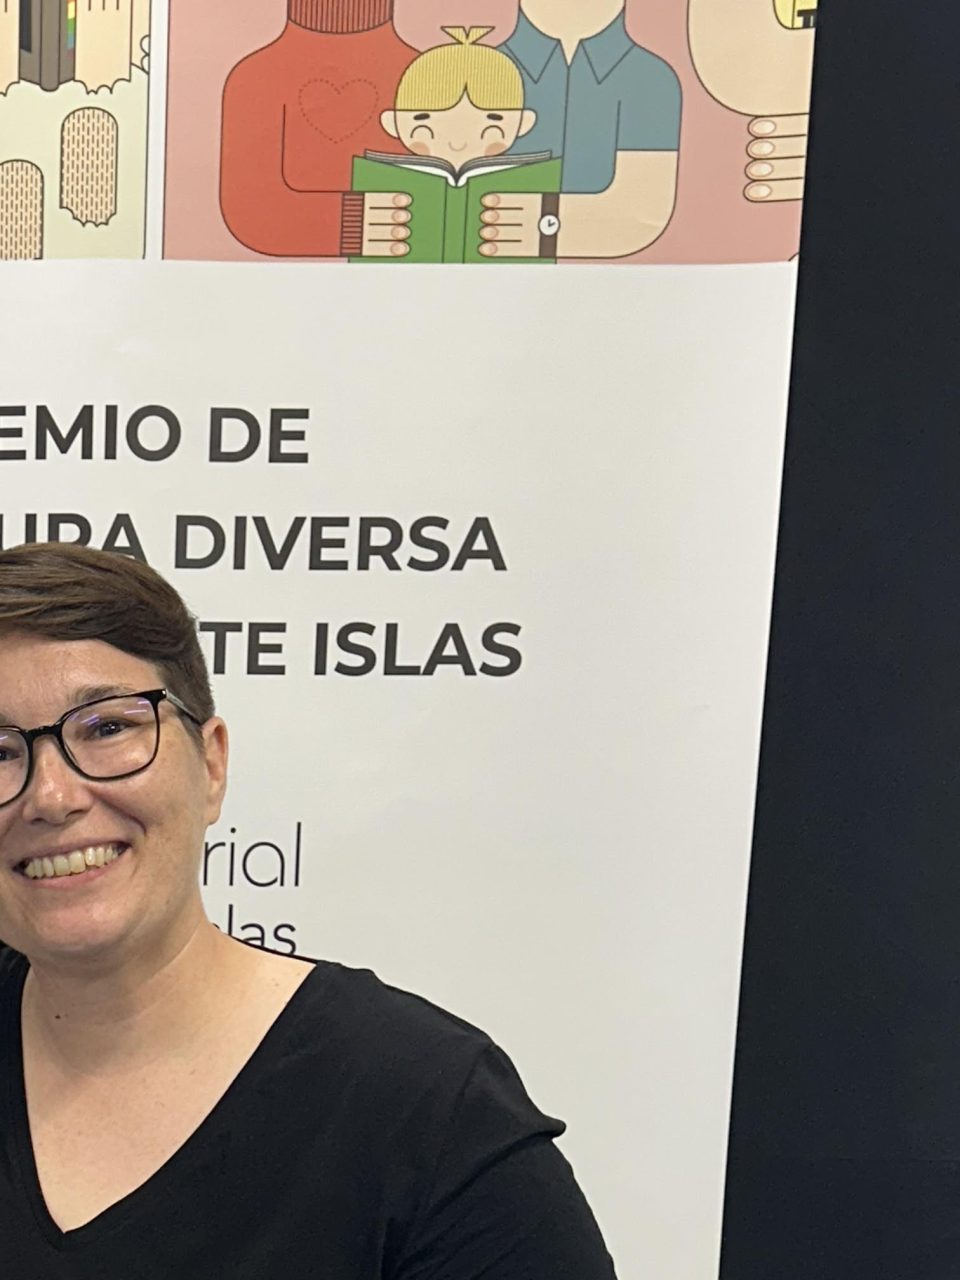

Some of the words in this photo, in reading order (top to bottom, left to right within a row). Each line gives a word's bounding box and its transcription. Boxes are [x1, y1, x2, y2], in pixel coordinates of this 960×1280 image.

[208, 407, 310, 464] DE
[174, 515, 508, 572] DIVERSA
[198, 621, 287, 675] TE
[313, 621, 522, 677] ISLAS
[203, 821, 301, 887] rial
[212, 904, 296, 955] las
